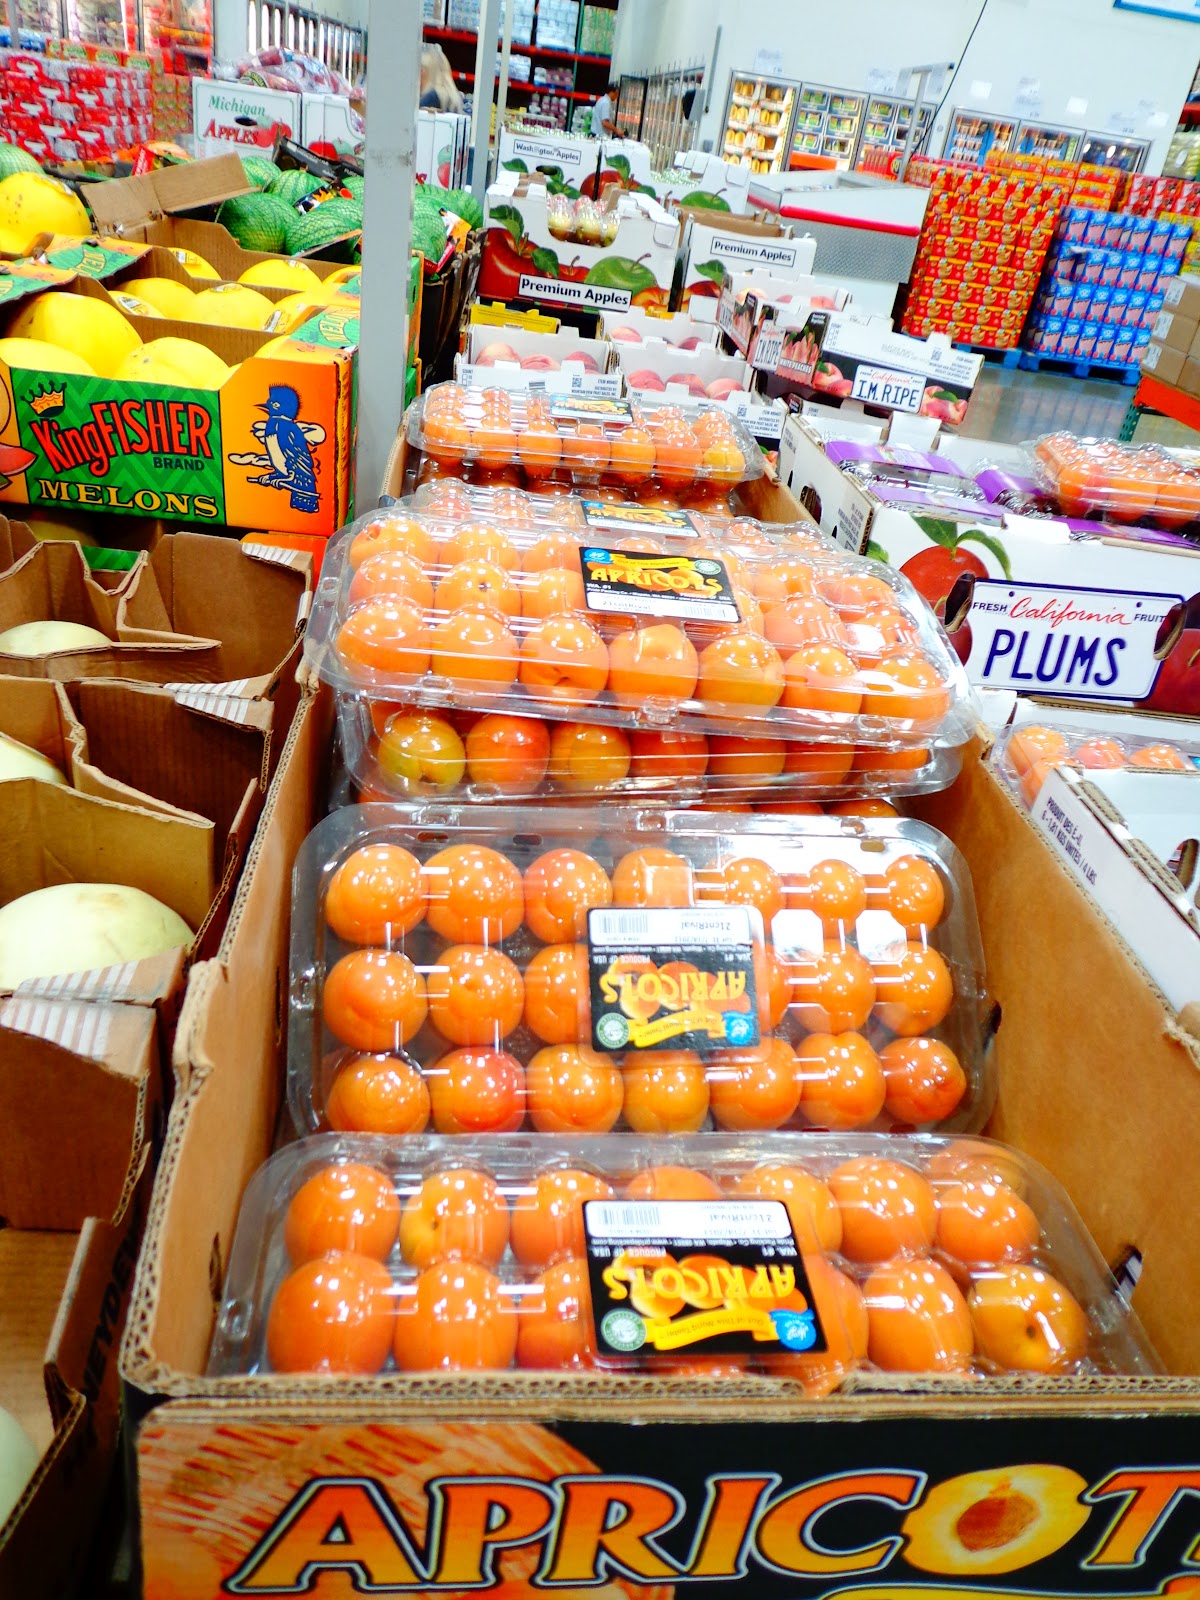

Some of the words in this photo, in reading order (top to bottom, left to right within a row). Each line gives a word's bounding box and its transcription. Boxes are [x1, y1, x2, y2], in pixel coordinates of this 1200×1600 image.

[208, 95, 266, 117] Michigan
[203, 118, 259, 145] APPLES
[516, 143, 554, 157] Washgton
[555, 149, 580, 162] Apples
[714, 241, 758, 257] Premium
[759, 248, 792, 262] Apples
[521, 278, 581, 298] Premium
[584, 288, 629, 307] Apples
[871, 371, 911, 384] California
[881, 383, 920, 408] RIPE
[153, 456, 205, 472] BRAND
[35, 478, 220, 519] MELONS
[590, 509, 687, 527] APRICOTS
[591, 567, 723, 595] APRICOTS
[972, 601, 1008, 612] FRESH
[1008, 596, 1132, 628] California
[1134, 613, 1166, 624] FRUIT
[983, 628, 1127, 687] PLUMS
[599, 970, 746, 1004] APRICOTS
[613, 1246, 624, 1257] OF
[627, 1246, 667, 1257] PRODUCE
[749, 1237, 776, 1246] Packing
[602, 1263, 796, 1300] APRICOTS
[223, 1463, 1200, 1592] APRICOT
